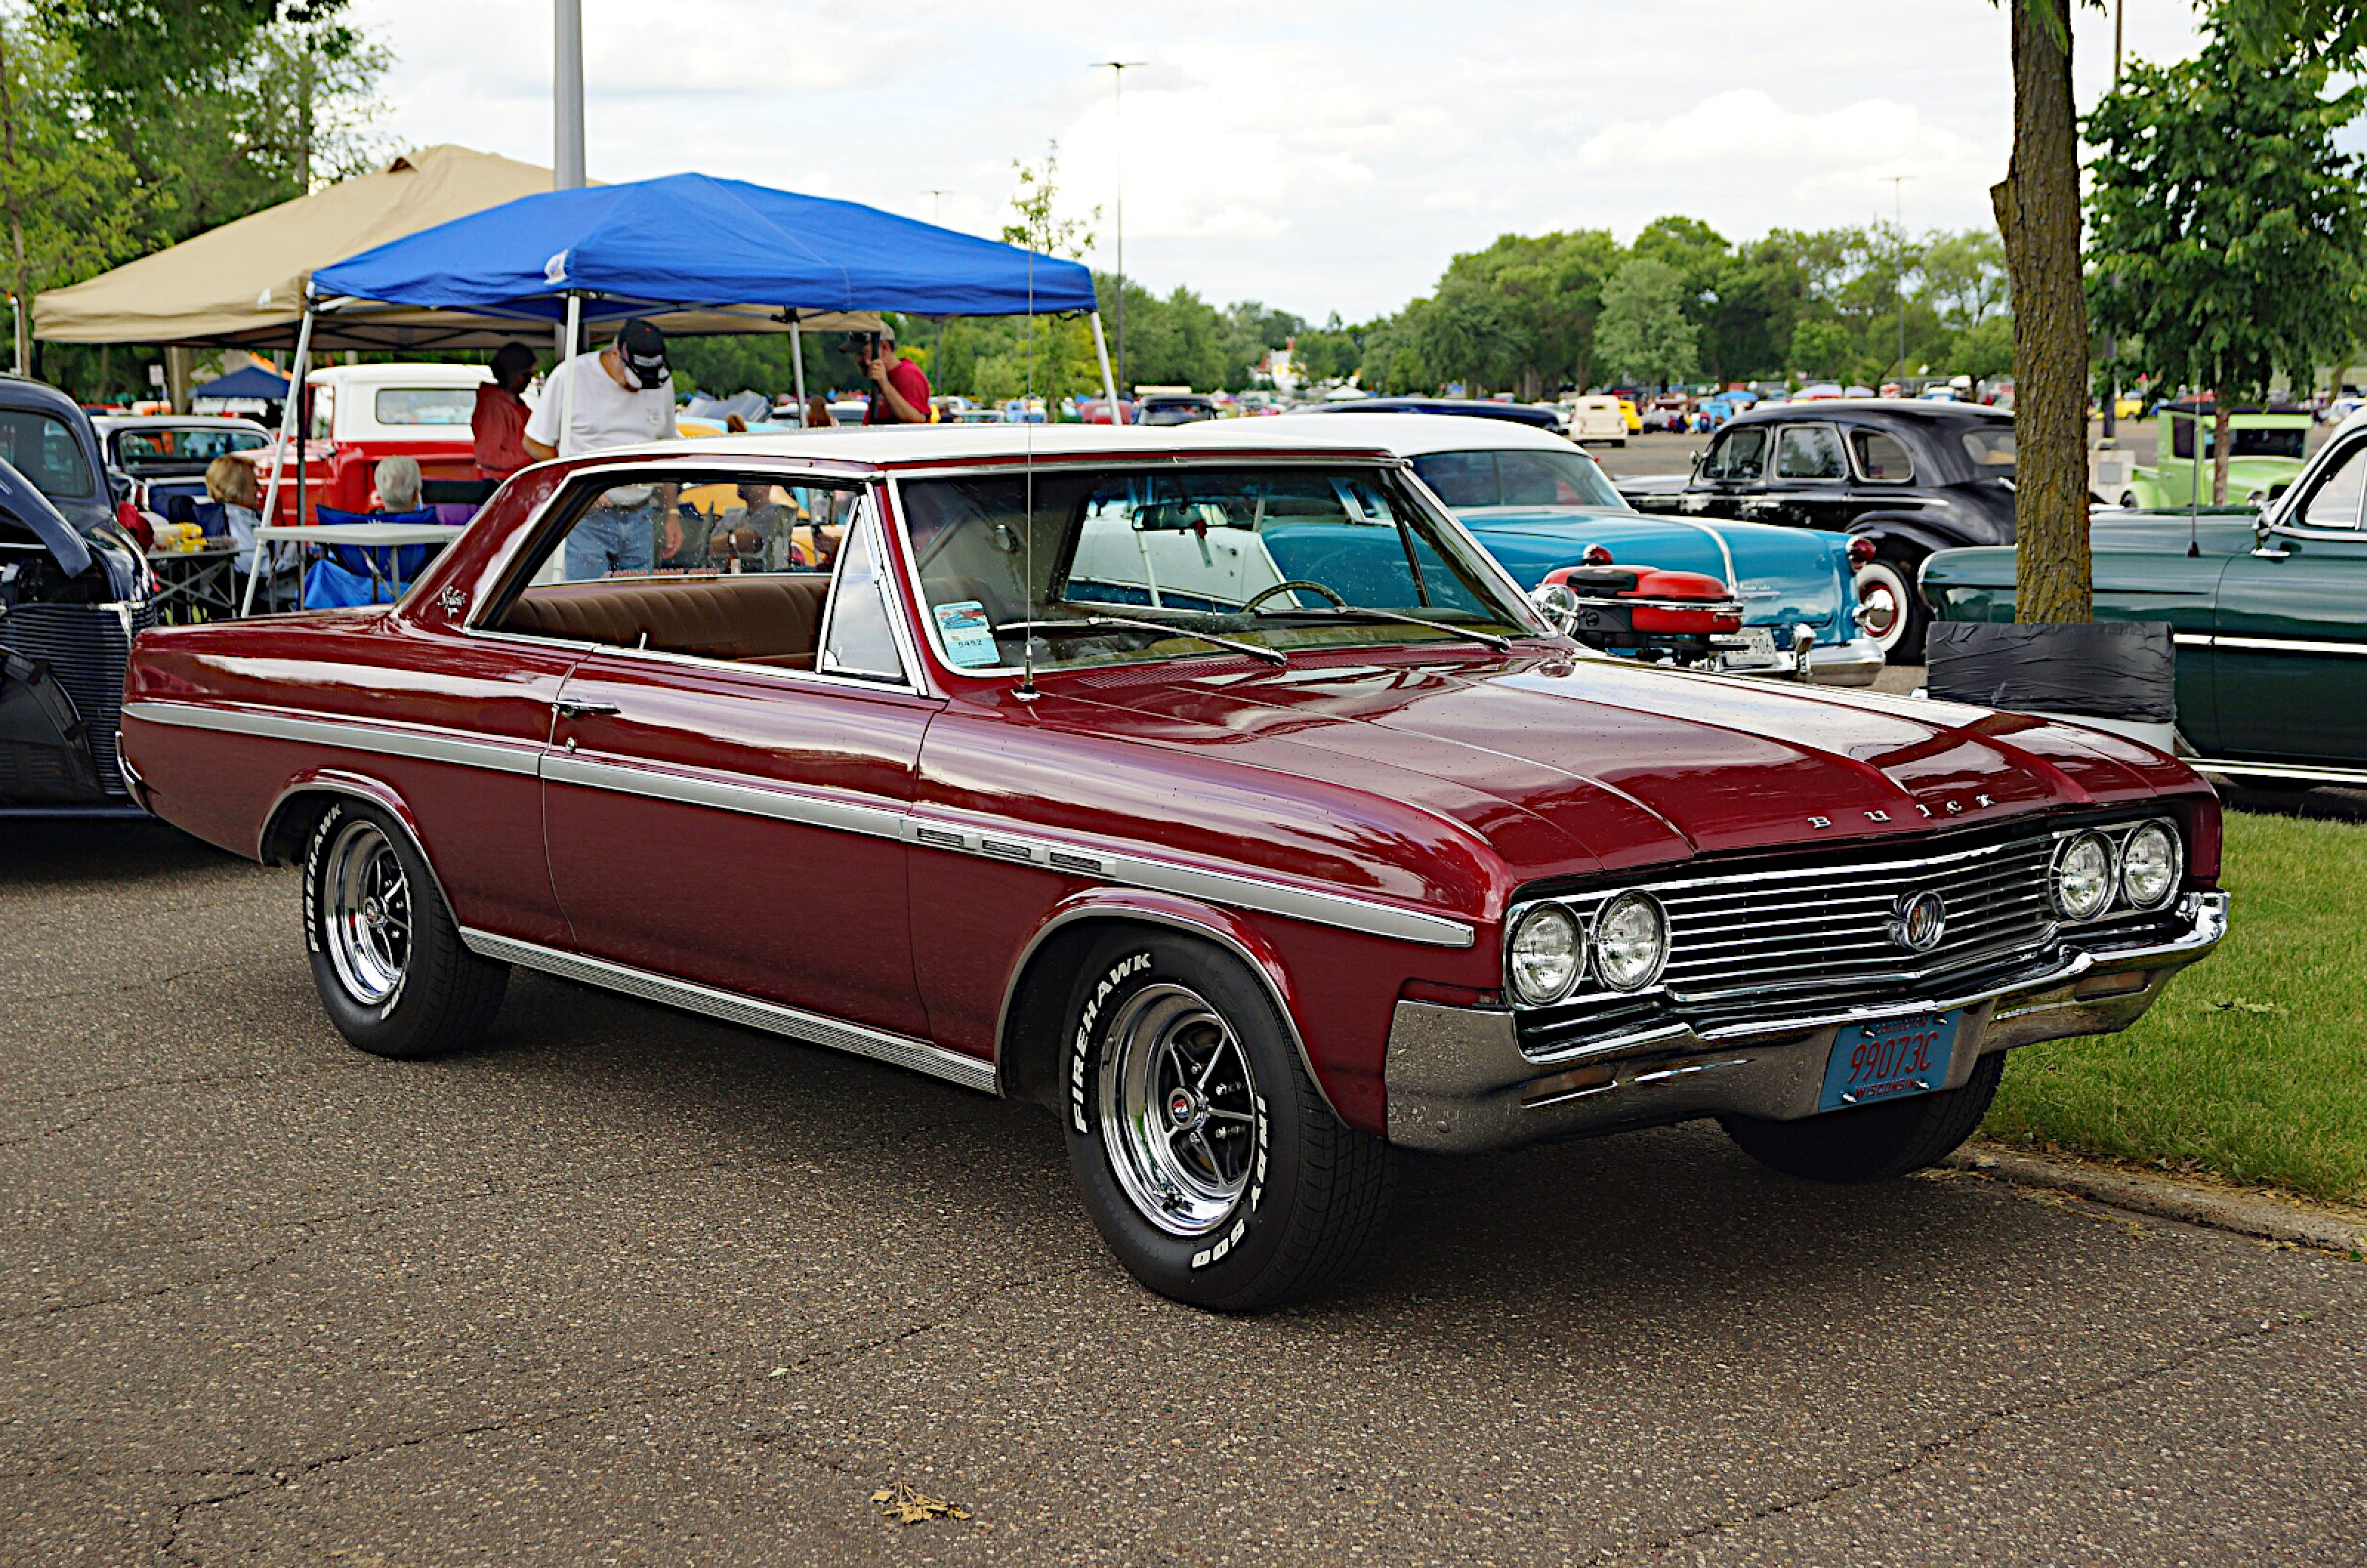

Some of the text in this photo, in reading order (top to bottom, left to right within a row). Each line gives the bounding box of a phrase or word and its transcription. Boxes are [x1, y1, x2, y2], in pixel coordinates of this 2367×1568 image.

[1807, 794, 1996, 829] BUICK
[306, 803, 342, 953] FIREHAWK
[1073, 953, 1151, 1134] FIREHAWK
[1848, 1030, 1939, 1084] 99073C
[1855, 1078, 1916, 1098] WISCONSIN
[1192, 1095, 1268, 1268] INDY 500
